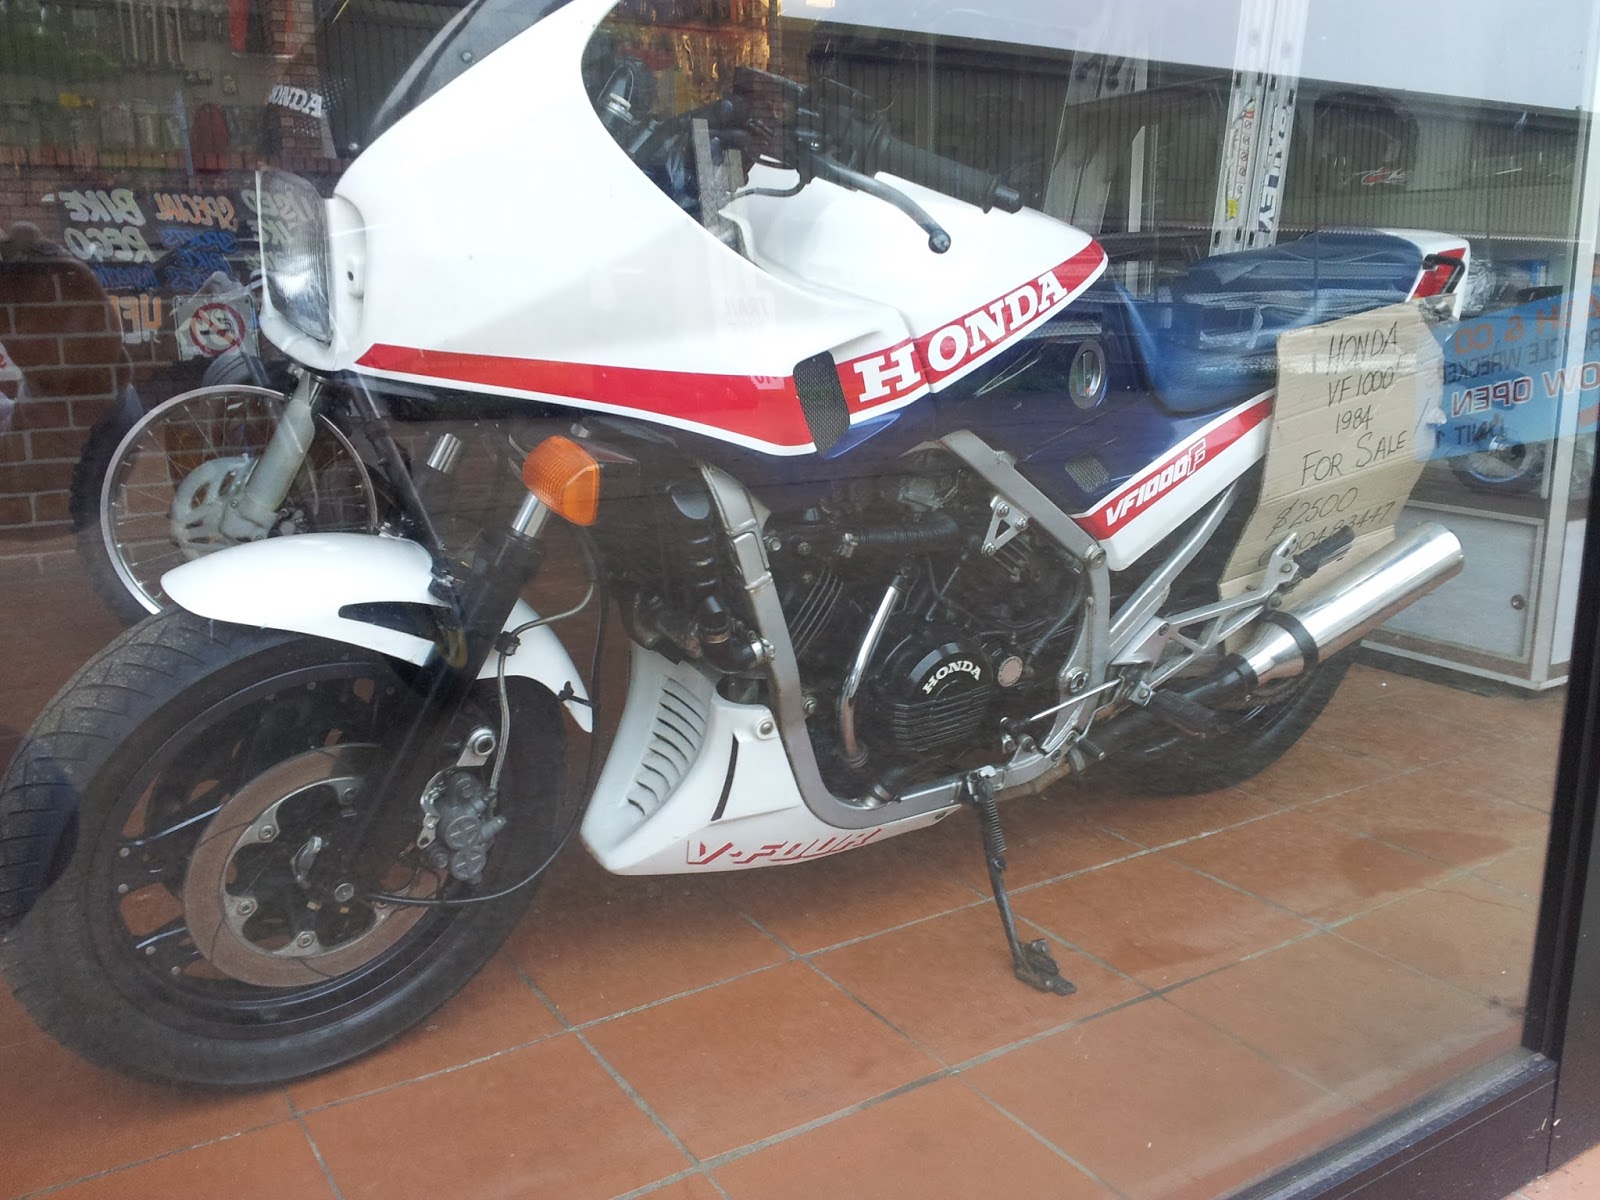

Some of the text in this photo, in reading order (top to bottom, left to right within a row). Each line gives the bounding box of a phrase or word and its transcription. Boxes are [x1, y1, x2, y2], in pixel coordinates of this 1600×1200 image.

[853, 271, 1068, 403] HONDA
[1326, 321, 1398, 375] HONDA
[1336, 405, 1374, 433] 1984
[1106, 438, 1206, 526] VF1000F
[1302, 431, 1407, 486] FOR SALE
[1266, 487, 1358, 540] $2500
[922, 660, 981, 694] HONDA
